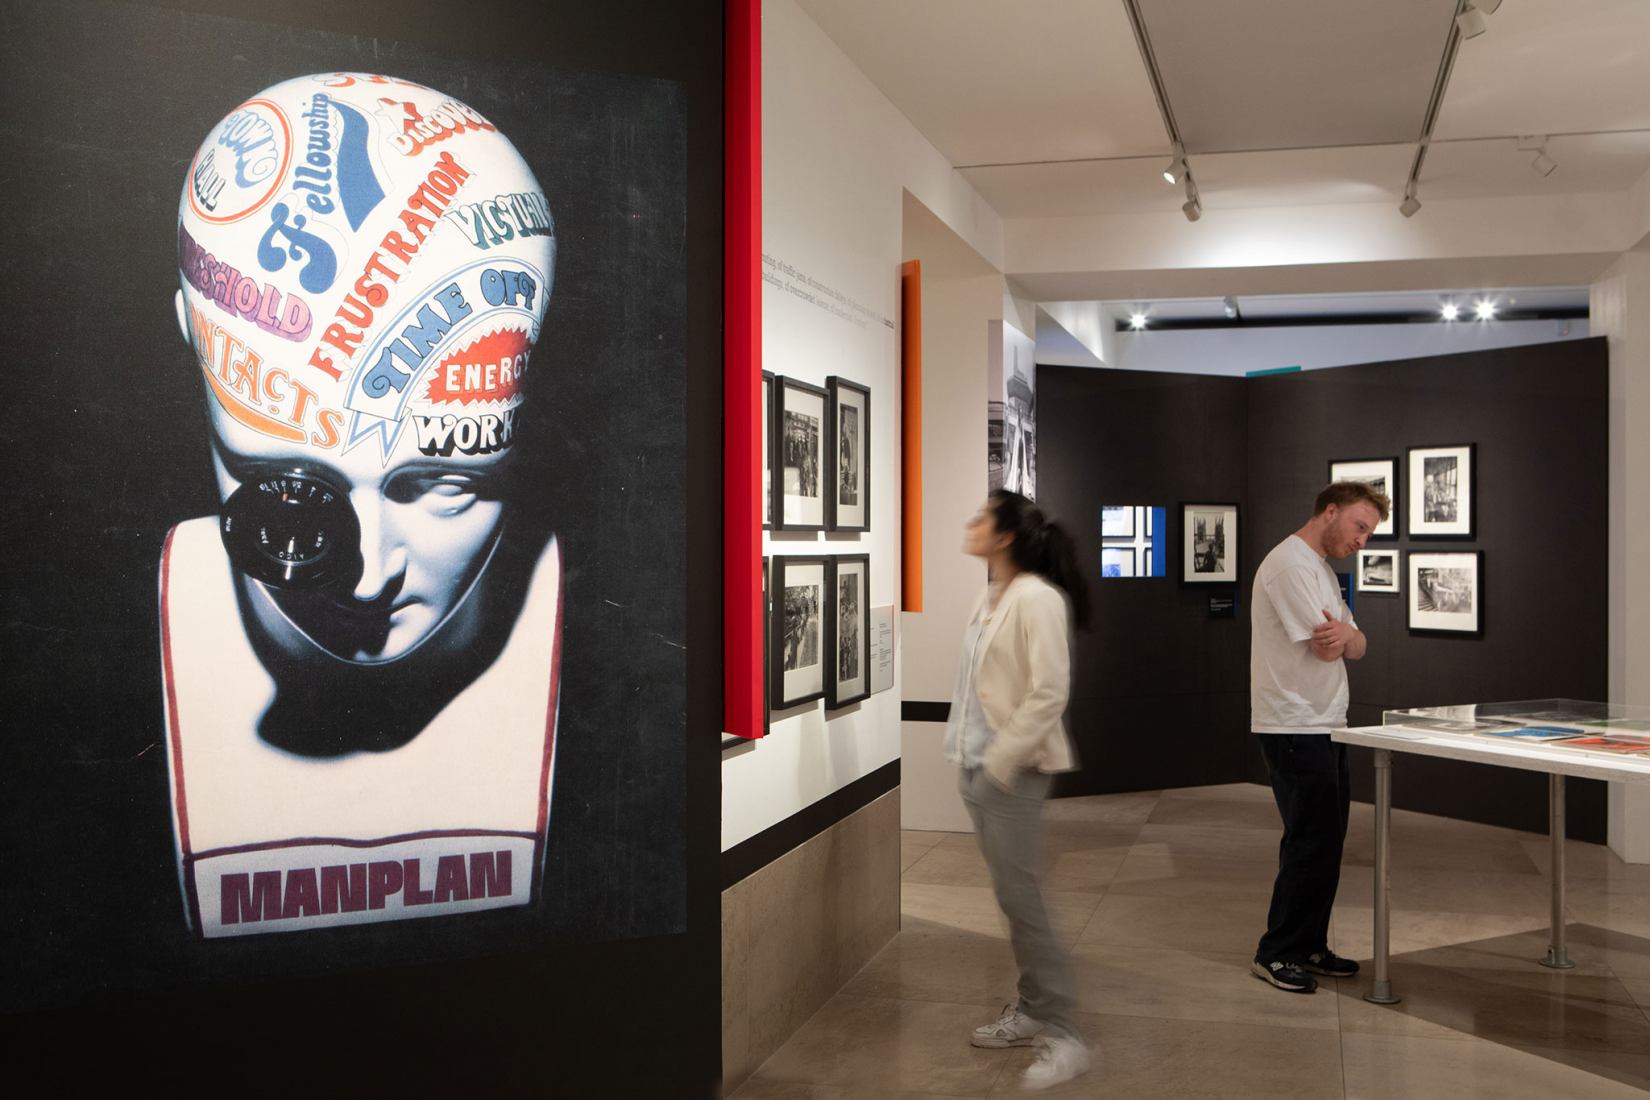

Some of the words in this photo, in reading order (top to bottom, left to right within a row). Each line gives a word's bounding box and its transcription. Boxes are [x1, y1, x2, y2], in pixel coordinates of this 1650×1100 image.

[257, 92, 338, 294] Fellowship
[307, 150, 472, 384] FRUSTRATION
[190, 303, 344, 449] NTACTS
[361, 282, 473, 399] TIME
[446, 349, 531, 392] ENERGY
[220, 849, 513, 926] MANPLAN
